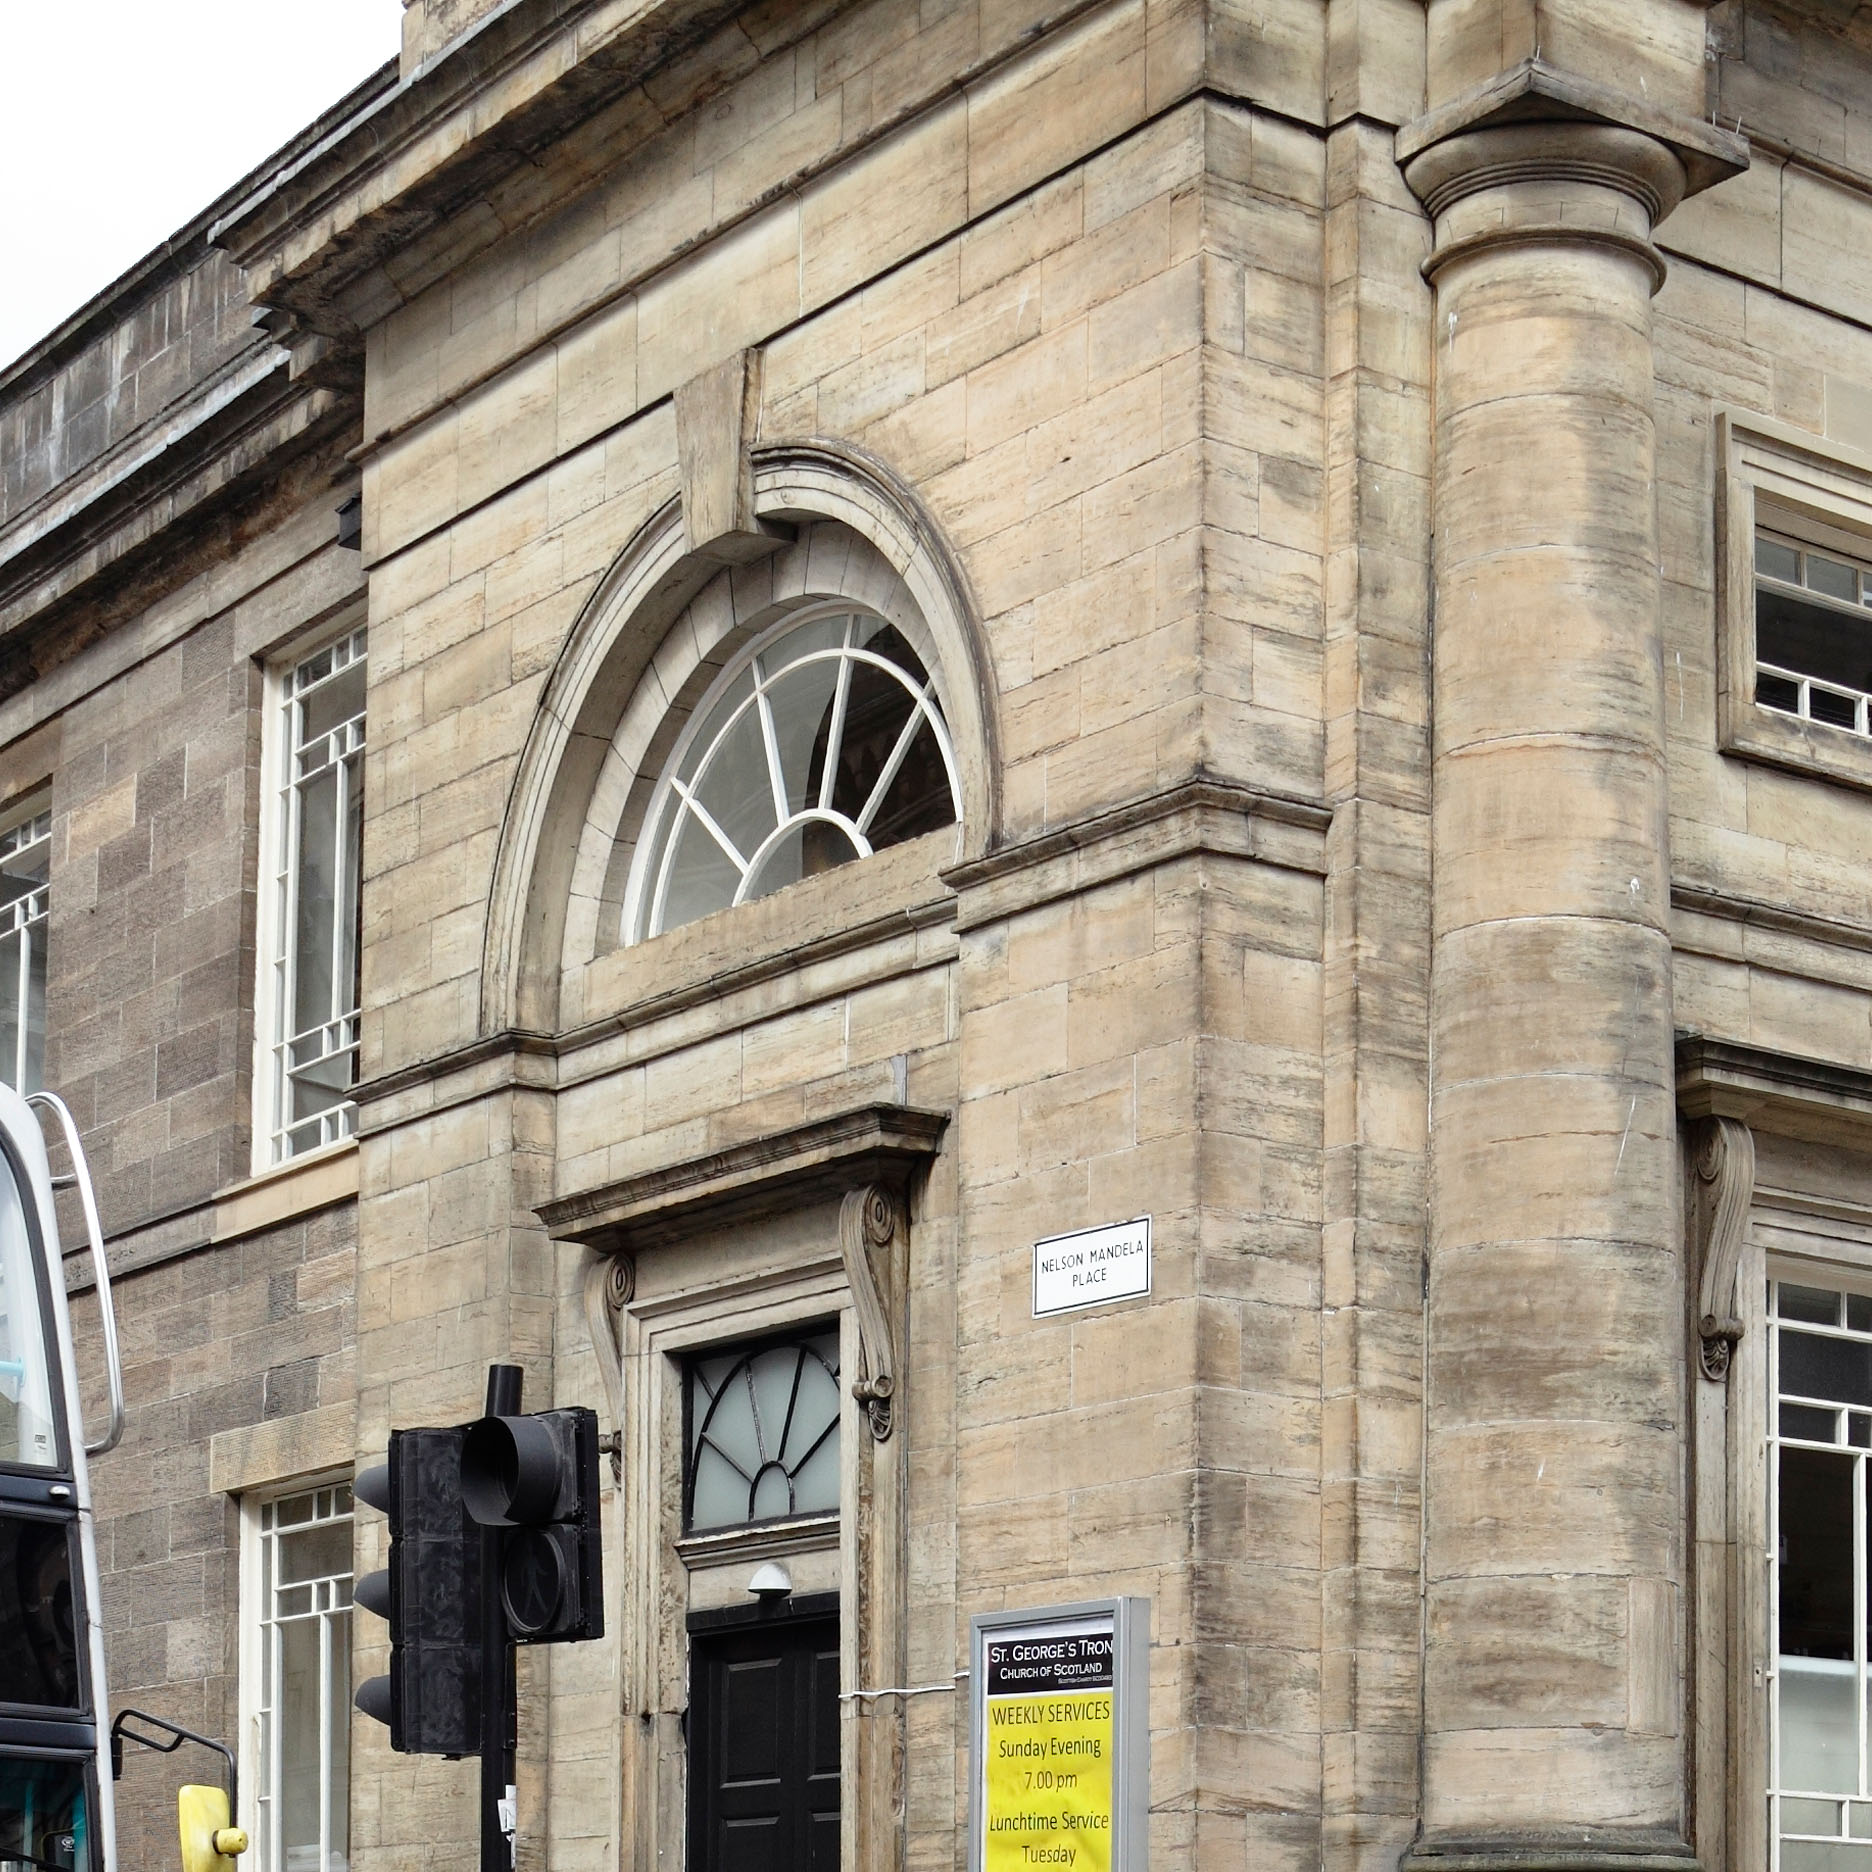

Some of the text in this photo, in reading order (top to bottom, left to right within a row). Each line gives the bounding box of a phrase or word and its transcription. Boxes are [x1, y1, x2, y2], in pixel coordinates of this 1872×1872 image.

[1041, 1240, 1144, 1274] NELSON MANDELA
[1072, 1268, 1107, 1287] PLACE
[991, 1639, 1113, 1663] ST. GEORGE'S TRON
[1000, 1662, 1103, 1680] CHURCH OF SCOTLAND
[992, 1701, 1110, 1725] WEEKLY SERVICES
[999, 1736, 1101, 1760] Sunday Evening
[1025, 1771, 1077, 1792] 7.00 pm
[989, 1811, 1109, 1831] Lunchtime Service
[1021, 1844, 1076, 1867] Tuesday
